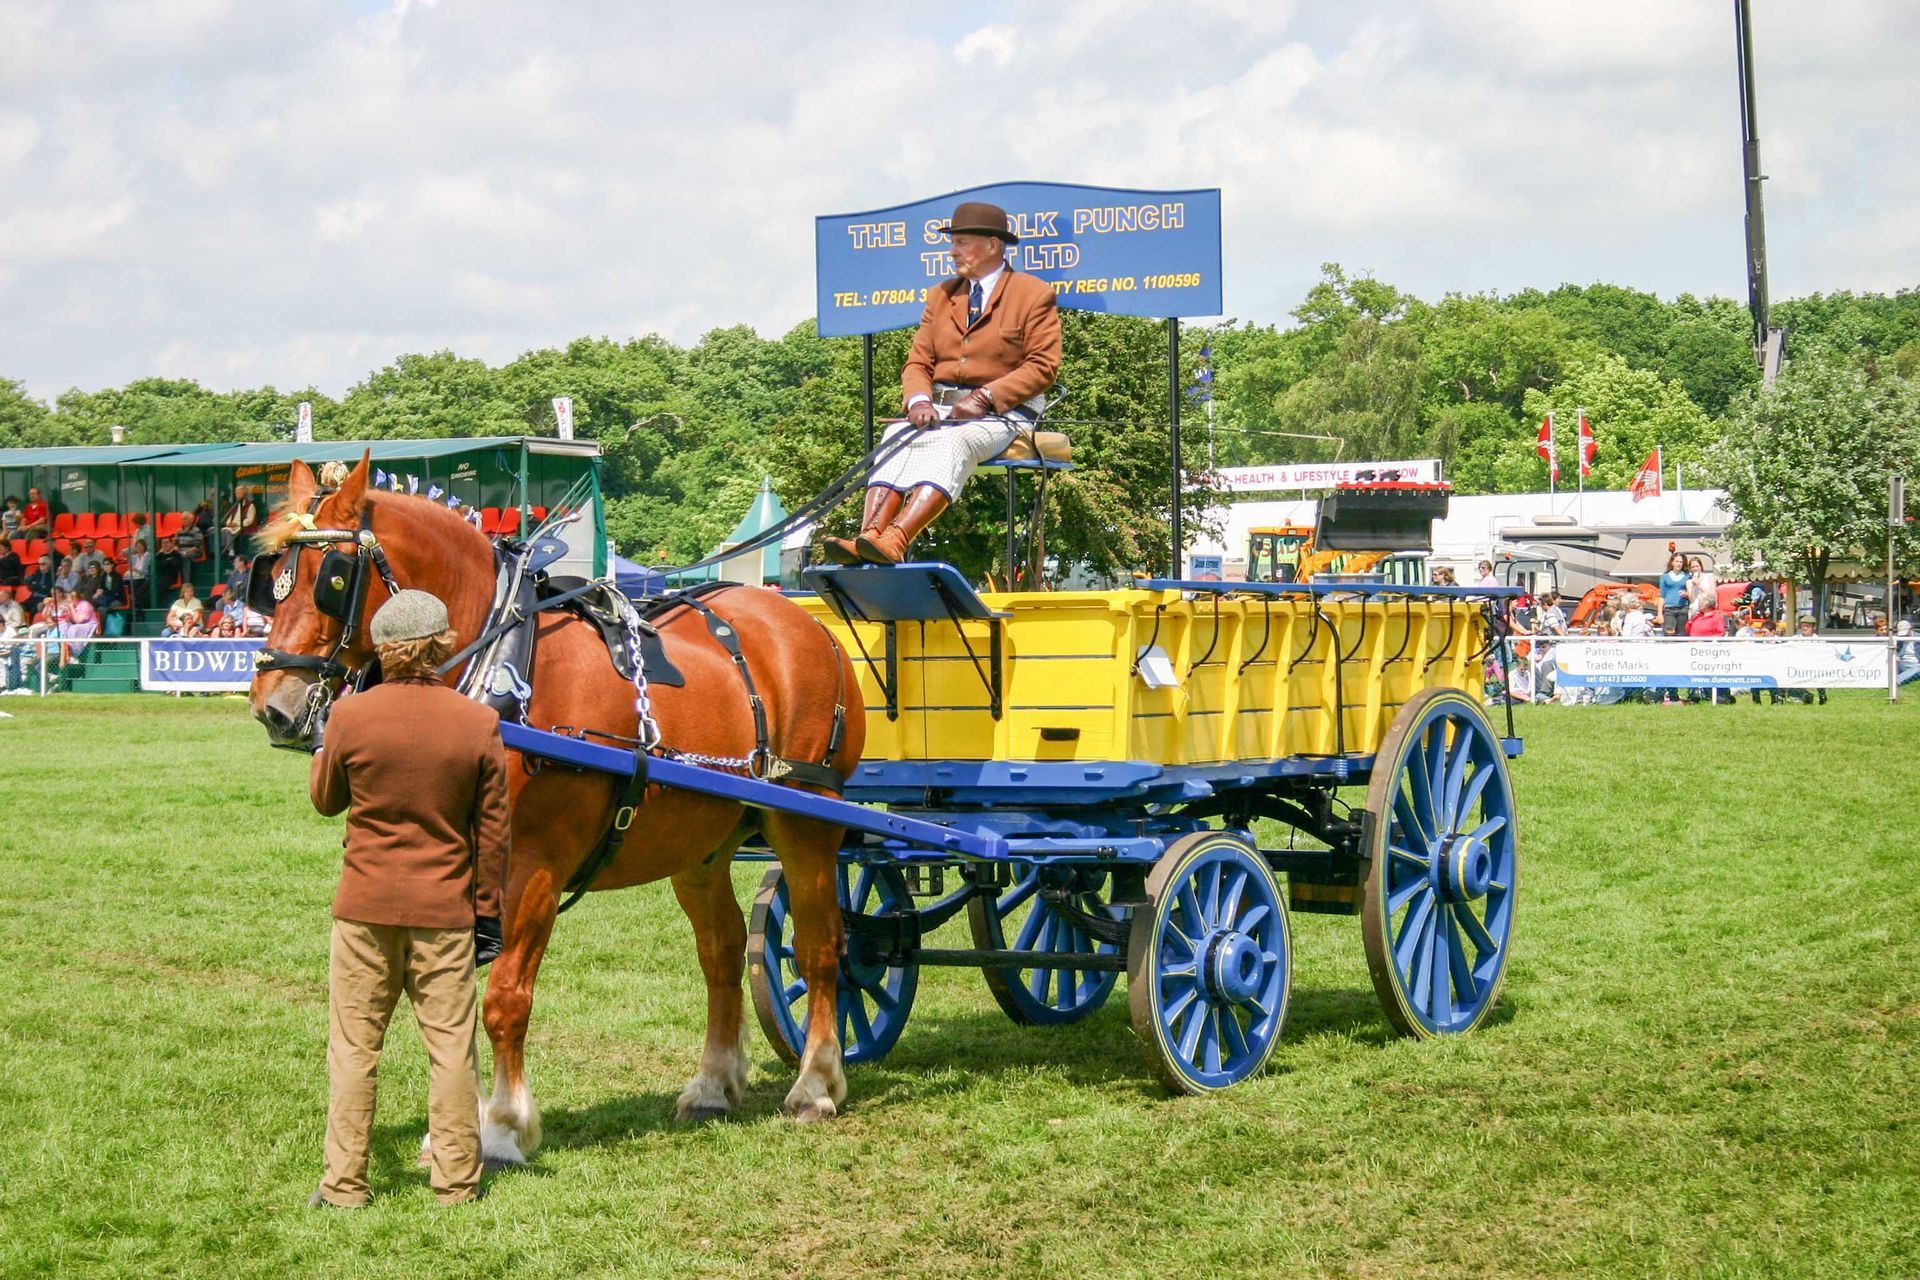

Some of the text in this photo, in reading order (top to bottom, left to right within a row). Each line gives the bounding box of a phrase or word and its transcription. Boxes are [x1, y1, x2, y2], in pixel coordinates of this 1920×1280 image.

[848, 221, 906, 249] THE
[1074, 203, 1185, 234] PUNCH
[920, 242, 1080, 277] TRT LTD
[1075, 279, 1108, 294] REG
[1111, 276, 1138, 291] NO.
[1143, 272, 1201, 289] 1100596
[834, 291, 867, 308] TEL:
[871, 288, 916, 306] 07804
[1234, 472, 1275, 485] HEALTH
[1281, 471, 1288, 482] &
[1293, 469, 1350, 482] LIFESTYLE
[1585, 647, 1624, 656] Patents
[1690, 647, 1731, 659] Designs
[1585, 660, 1649, 670] Trade Marks
[1690, 660, 1743, 673] Copyright
[1848, 666, 1882, 680] Copp
